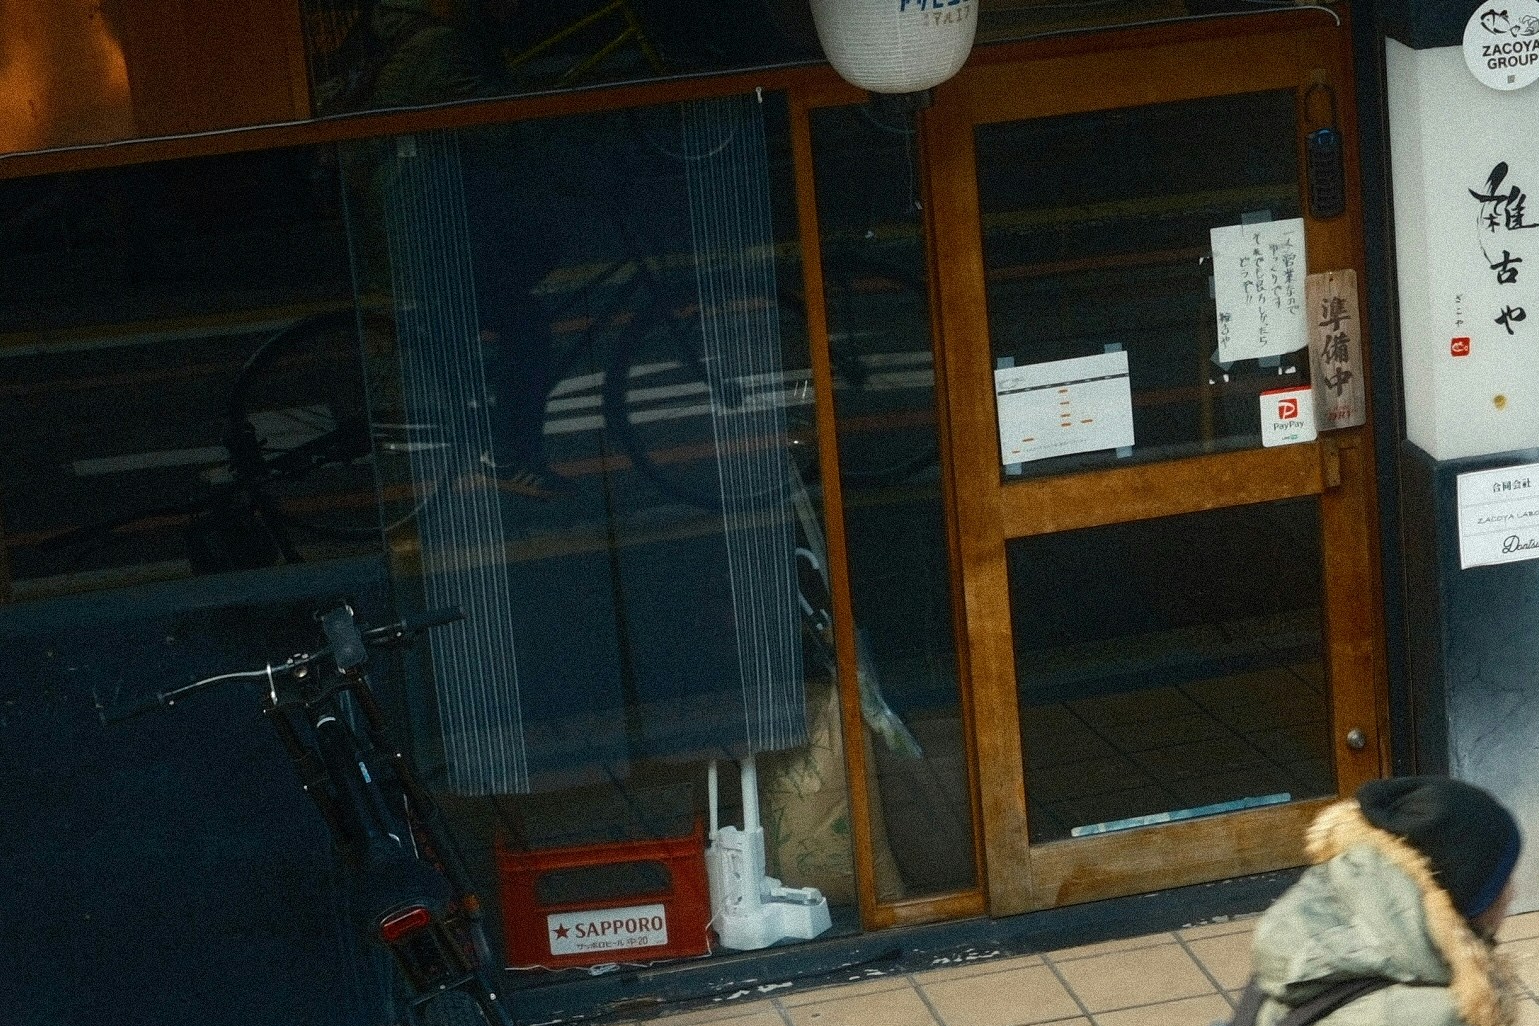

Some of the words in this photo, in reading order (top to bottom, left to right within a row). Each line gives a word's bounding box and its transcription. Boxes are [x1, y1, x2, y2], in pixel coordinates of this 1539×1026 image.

[1487, 53, 1539, 70] GROUP
[1455, 294, 1465, 328] ざこや
[1318, 296, 1352, 396] 準備中
[1273, 420, 1305, 432] PayPay
[1493, 478, 1531, 493] 合同会社
[1477, 513, 1514, 525] ZACOYA
[1517, 510, 1539, 519] LABO
[575, 915, 663, 939] SAPPORO
[576, 940, 624, 950] サッポロビール
